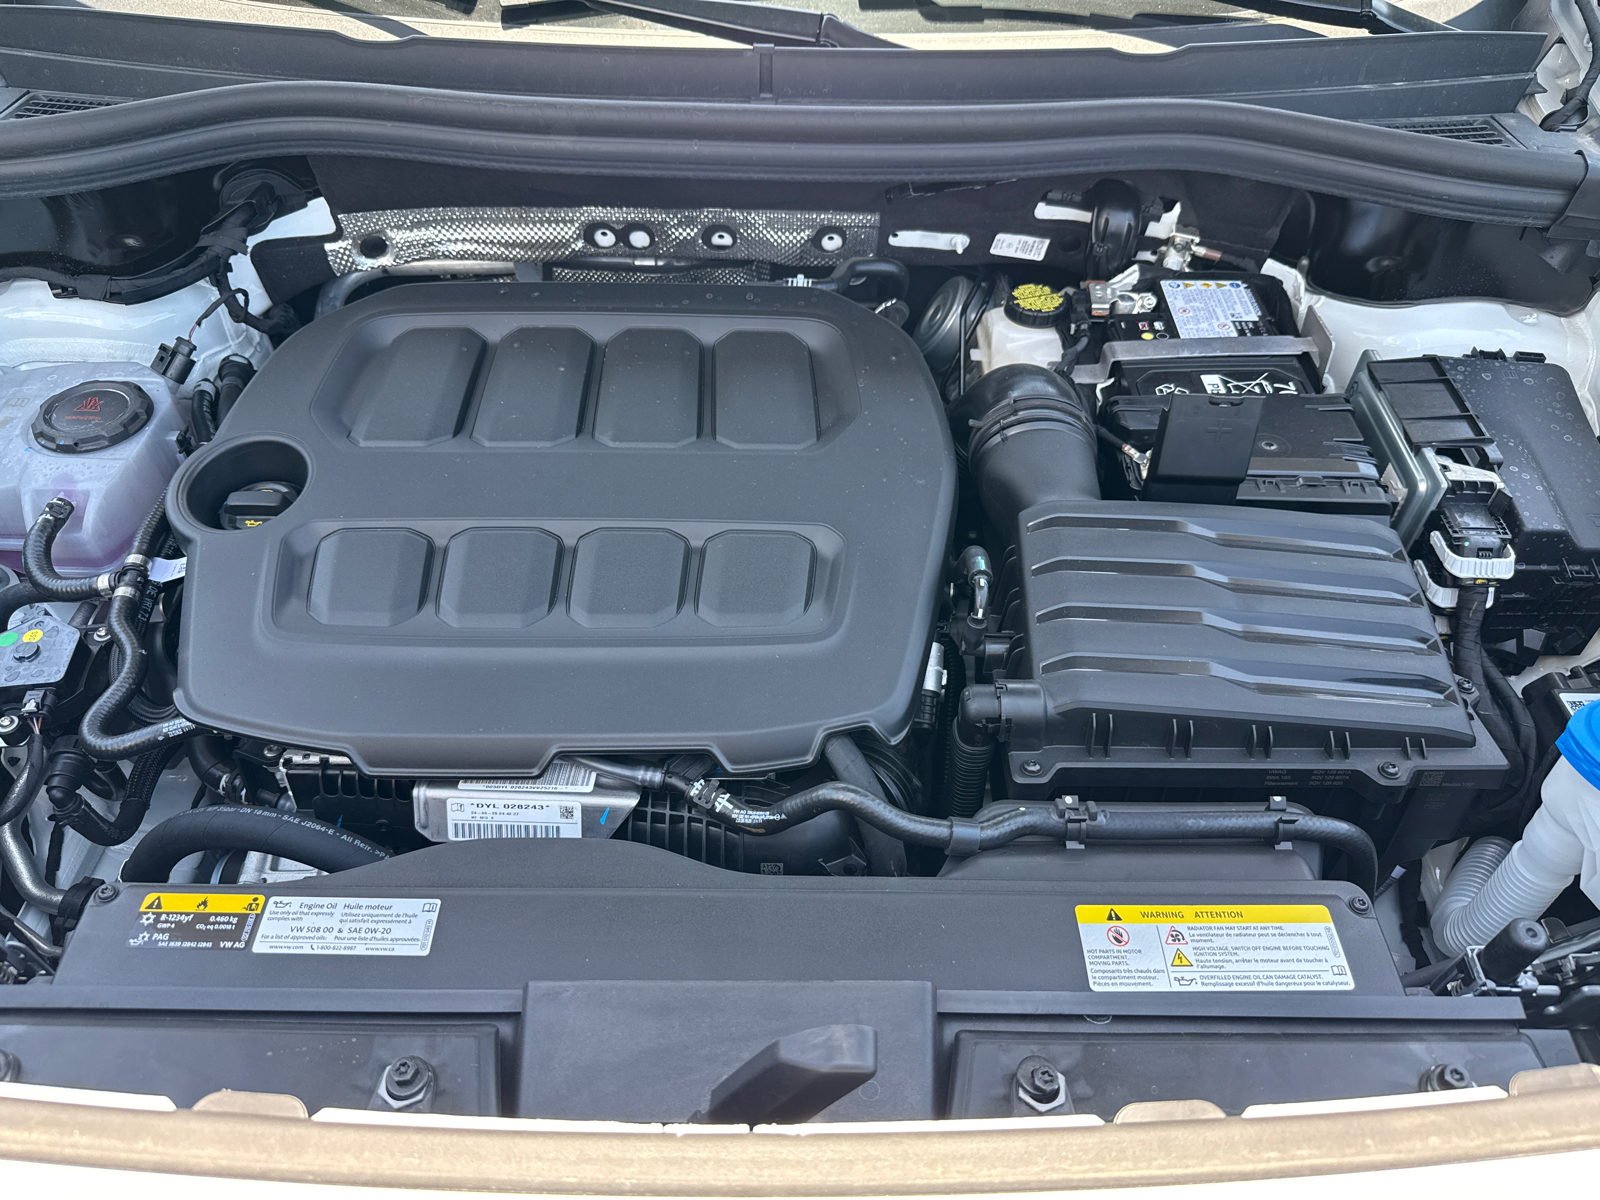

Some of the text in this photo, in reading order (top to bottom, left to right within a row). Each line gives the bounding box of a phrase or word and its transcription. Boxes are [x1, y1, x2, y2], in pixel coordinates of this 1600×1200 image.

[282, 815, 300, 824] SAE
[301, 820, 335, 835] J2064-E
[340, 834, 353, 842] All
[160, 914, 194, 923] R-1234yf
[230, 916, 238, 924] kg
